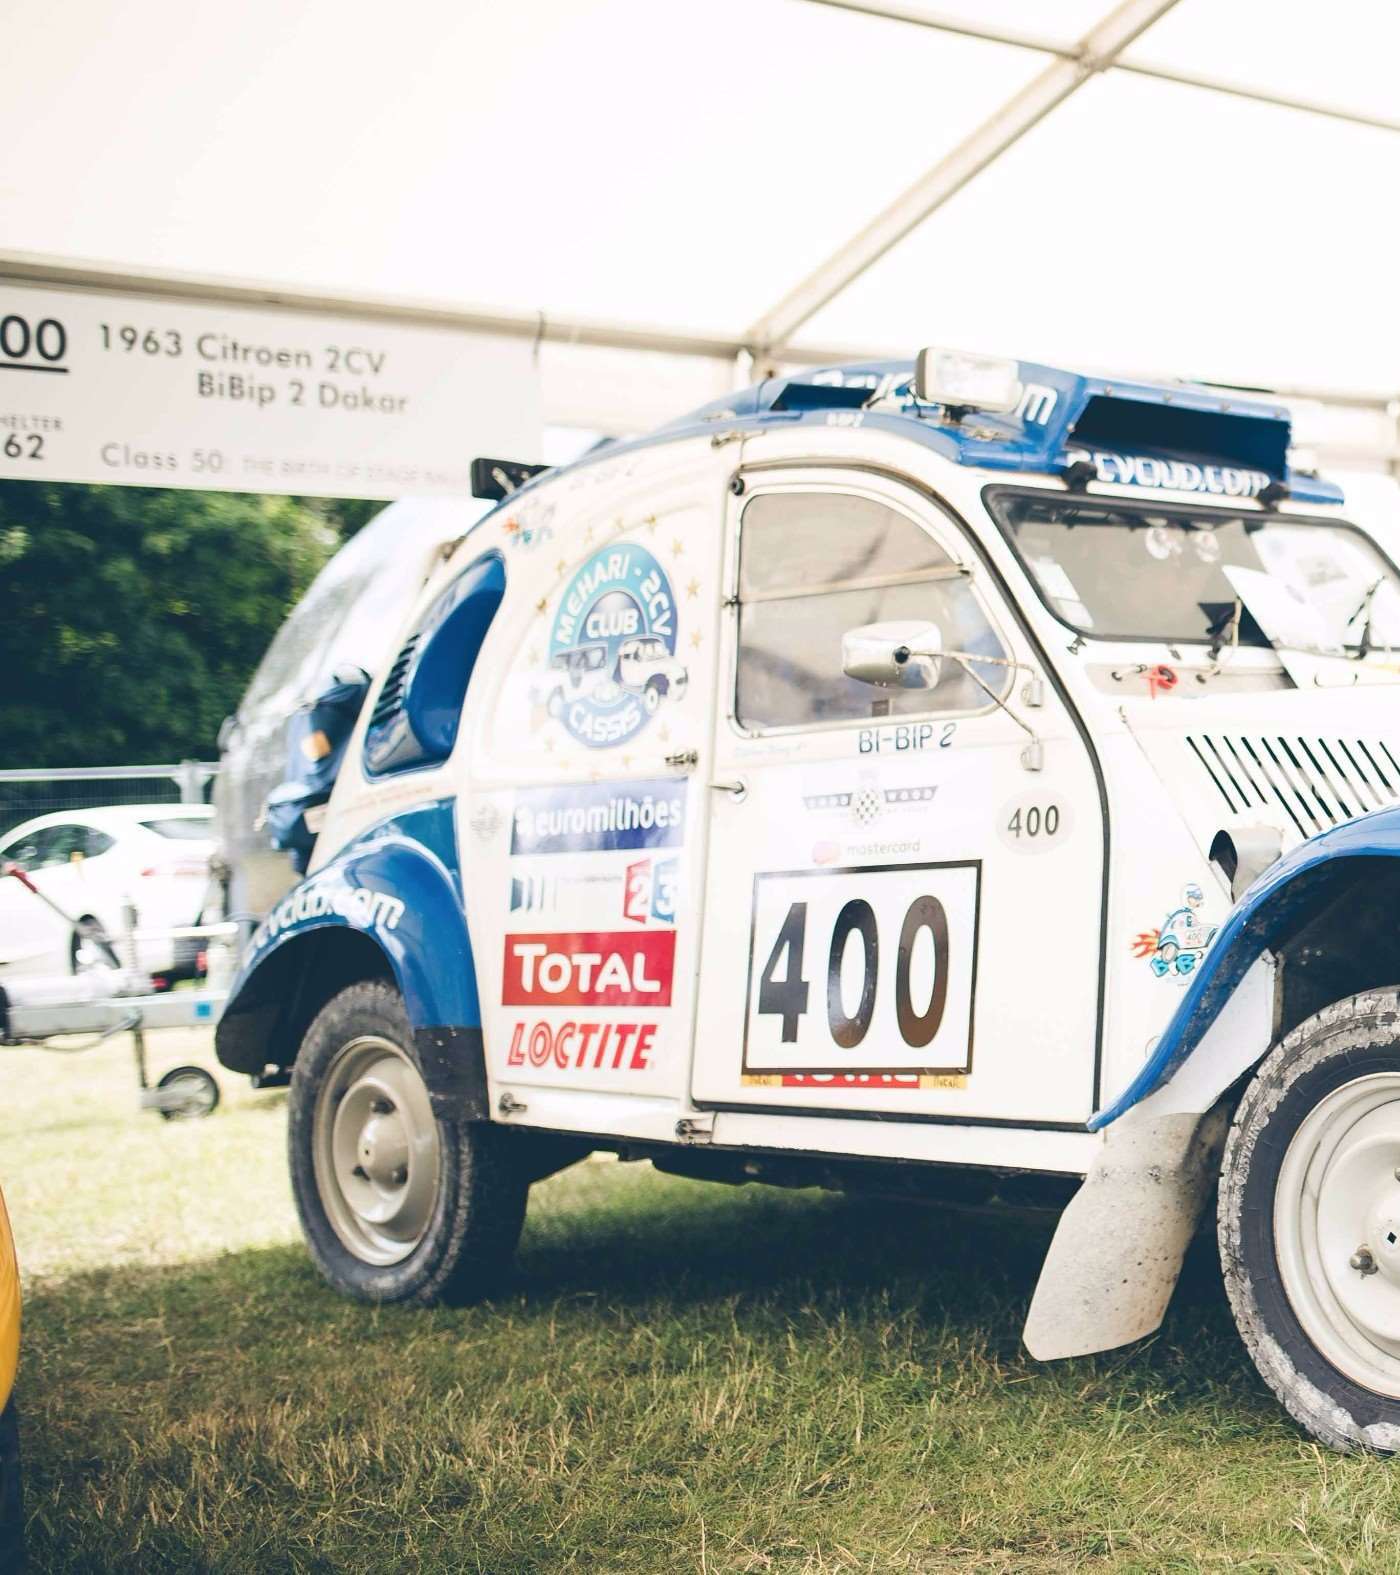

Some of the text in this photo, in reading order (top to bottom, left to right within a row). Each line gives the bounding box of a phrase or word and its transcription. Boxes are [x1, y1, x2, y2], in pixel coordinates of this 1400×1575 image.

[100, 323, 387, 378] 1963 Citroen 2CV
[197, 372, 409, 415] BiBip 2 Dakar
[3, 432, 46, 462] 62
[100, 441, 178, 472] Class
[585, 608, 639, 639] CLUB
[858, 722, 958, 754] BI-BIP 2
[534, 794, 682, 837] euromilhões
[1007, 804, 1060, 838] 400
[847, 837, 922, 857] mastercard
[757, 894, 950, 1049] 400
[506, 1020, 659, 1070] LOCTITE
